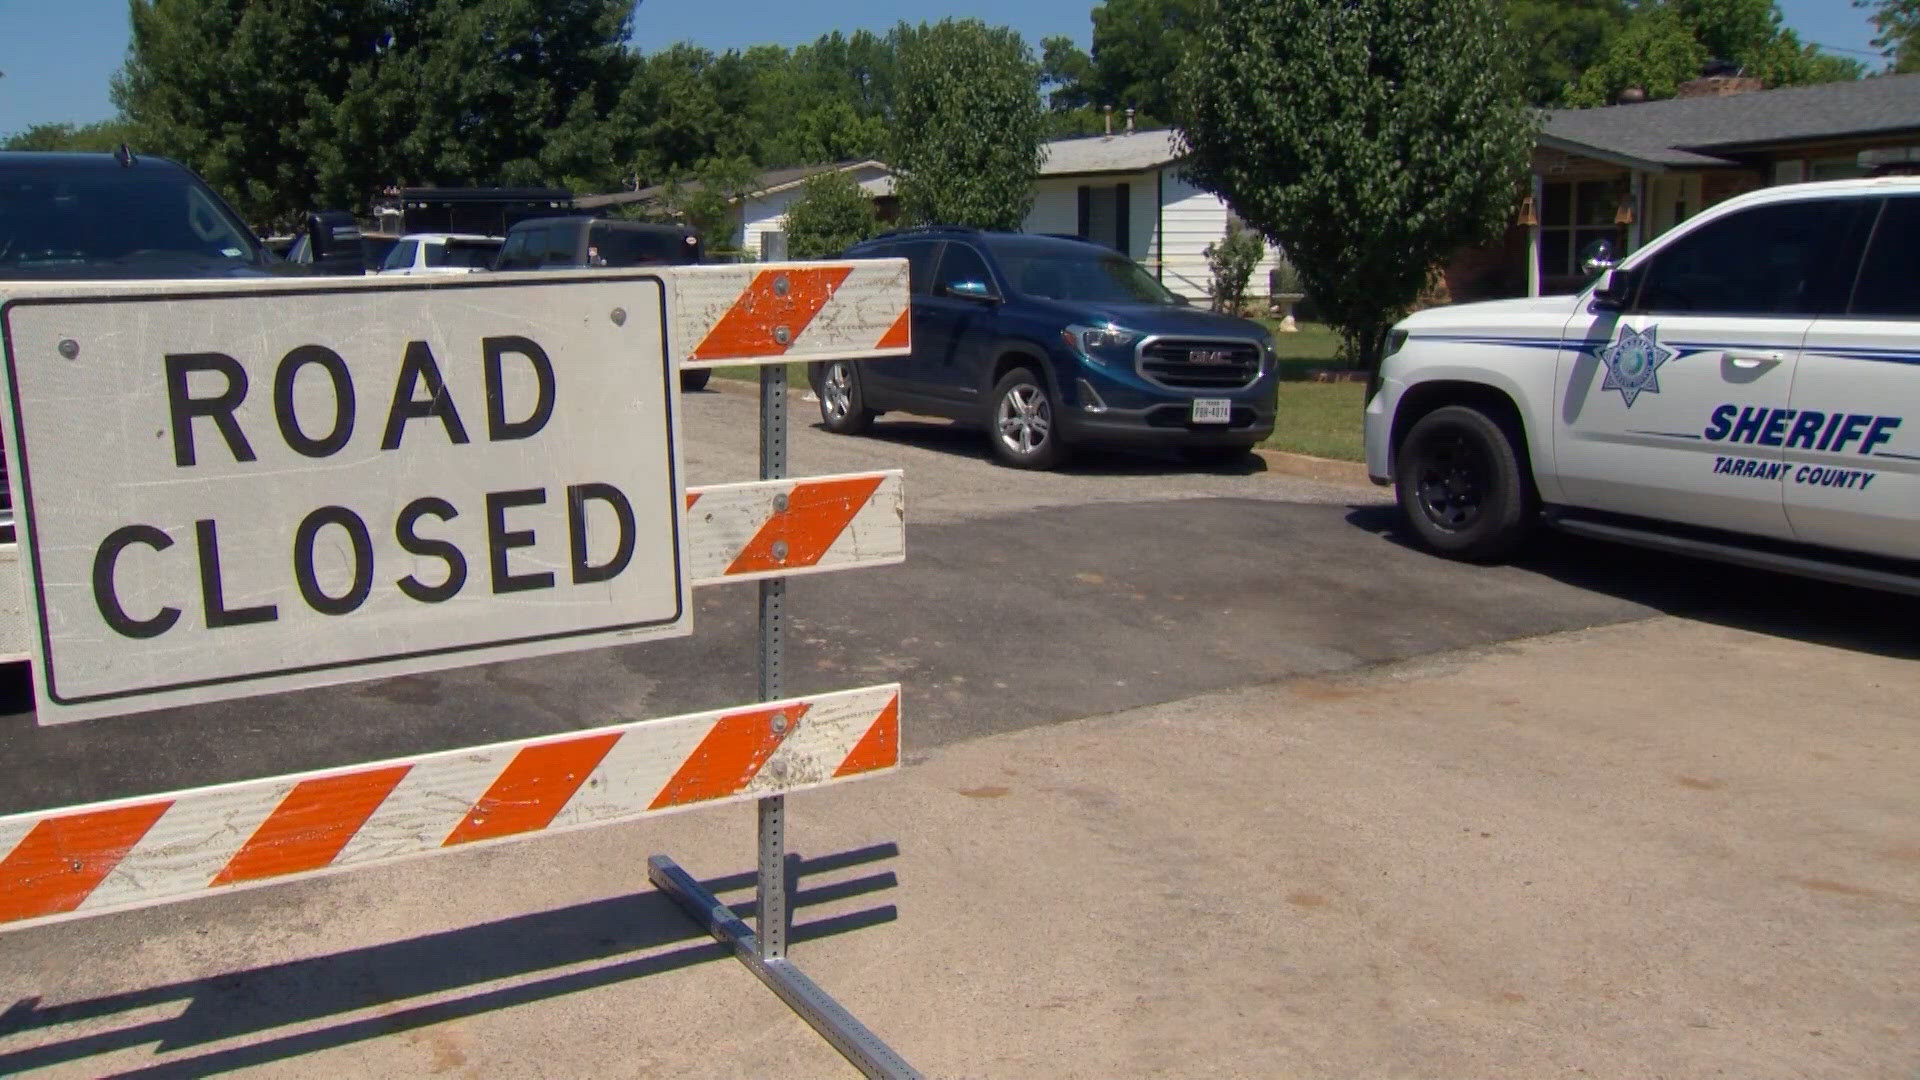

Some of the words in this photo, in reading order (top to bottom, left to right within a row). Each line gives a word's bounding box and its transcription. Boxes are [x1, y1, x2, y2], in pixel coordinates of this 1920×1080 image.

[1189, 351, 1232, 364] GMC
[164, 335, 556, 467] ROAD
[1704, 404, 1902, 454] SHERIFF
[1713, 457, 1791, 482] TARRANT
[1795, 467, 1875, 490] COUNTY
[92, 482, 636, 639] CLOSED
